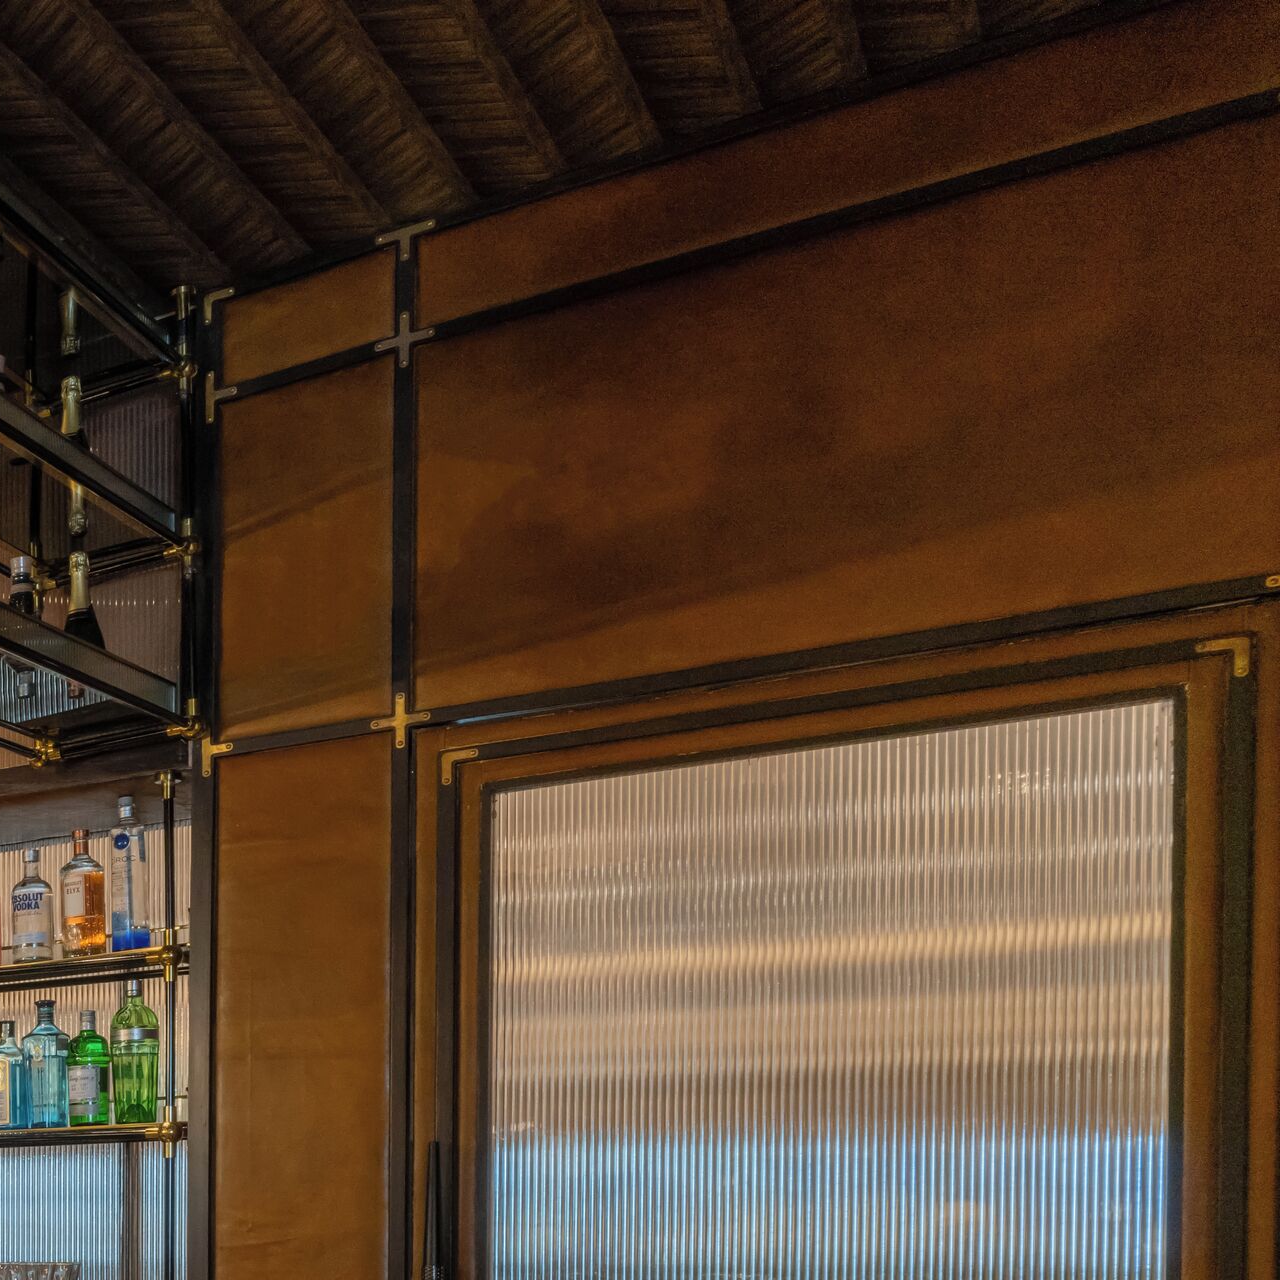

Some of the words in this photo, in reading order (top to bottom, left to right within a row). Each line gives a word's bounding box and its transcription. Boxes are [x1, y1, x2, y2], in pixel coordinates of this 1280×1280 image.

[66, 887, 81, 895] ELYX
[12, 892, 44, 904] BSOLUT
[13, 901, 40, 913] VODKA
